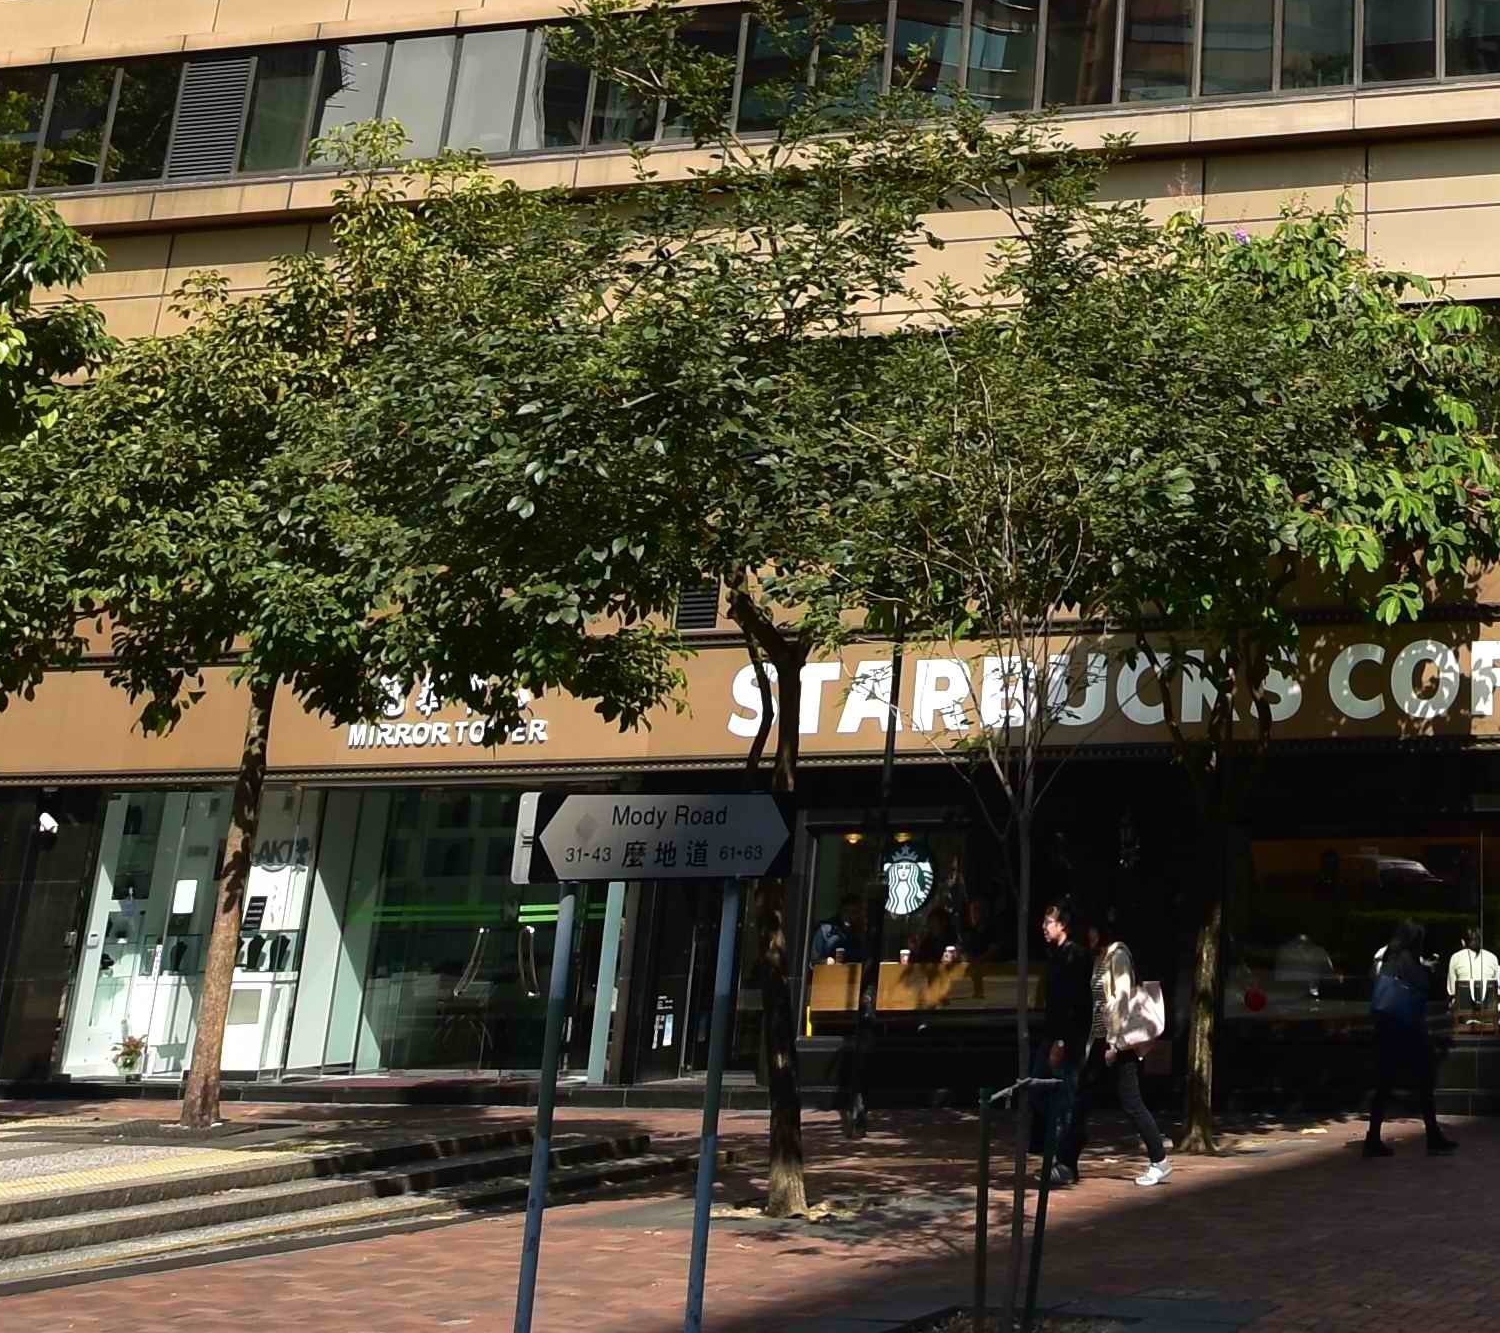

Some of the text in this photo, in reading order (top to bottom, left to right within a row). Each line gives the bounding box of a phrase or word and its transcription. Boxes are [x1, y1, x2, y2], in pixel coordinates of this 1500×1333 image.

[726, 648, 1302, 738] STARBUCKS
[348, 718, 550, 748] MIRROR TOER
[611, 804, 728, 829] Mody Road
[621, 840, 709, 868] 麼地道
